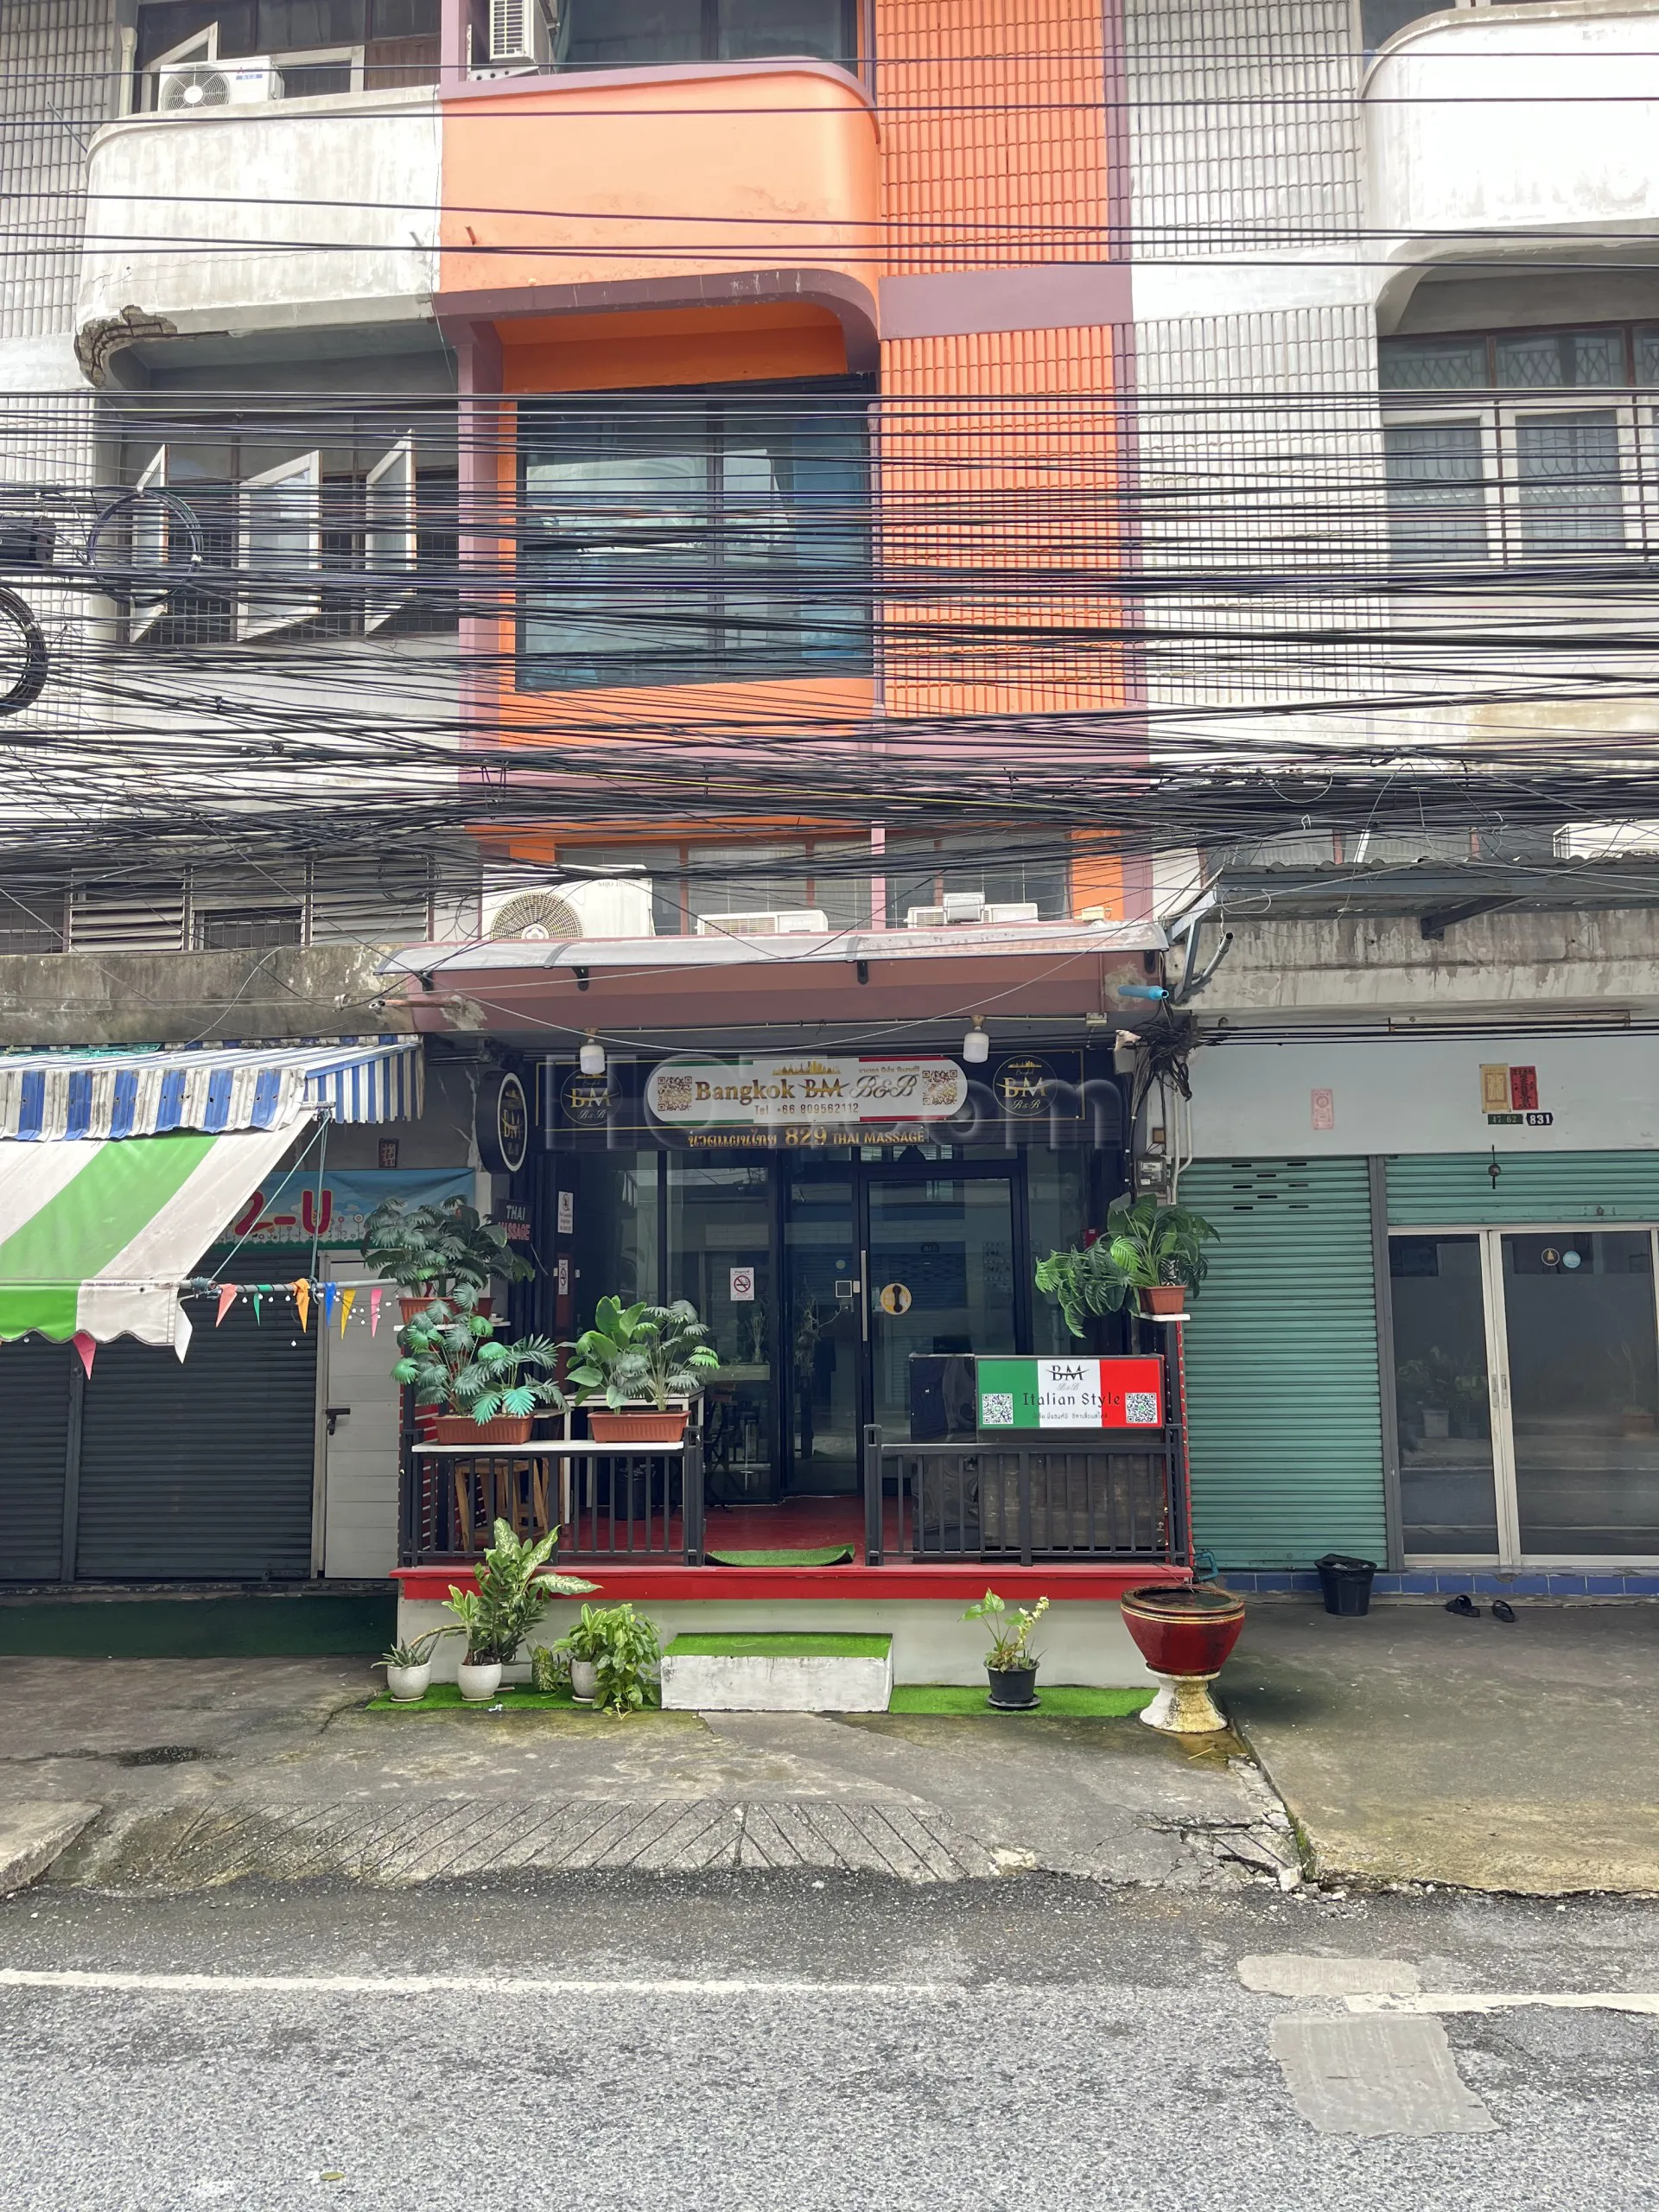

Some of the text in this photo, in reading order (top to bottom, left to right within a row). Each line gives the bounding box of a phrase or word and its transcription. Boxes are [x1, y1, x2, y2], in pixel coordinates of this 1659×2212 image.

[695, 1073, 920, 1106] Bangkok BM B&B
[1001, 1077, 1048, 1097] BM
[569, 1088, 613, 1108] BM
[800, 1103, 859, 1115] 809562112
[1529, 1114, 1551, 1125] 831
[688, 1127, 926, 1147] นวดแผนไทย 829 THAI MASSAGE
[505, 1205, 526, 1221] THAI
[1048, 1364, 1087, 1382] BM
[1022, 1392, 1121, 1408] Italian Style
